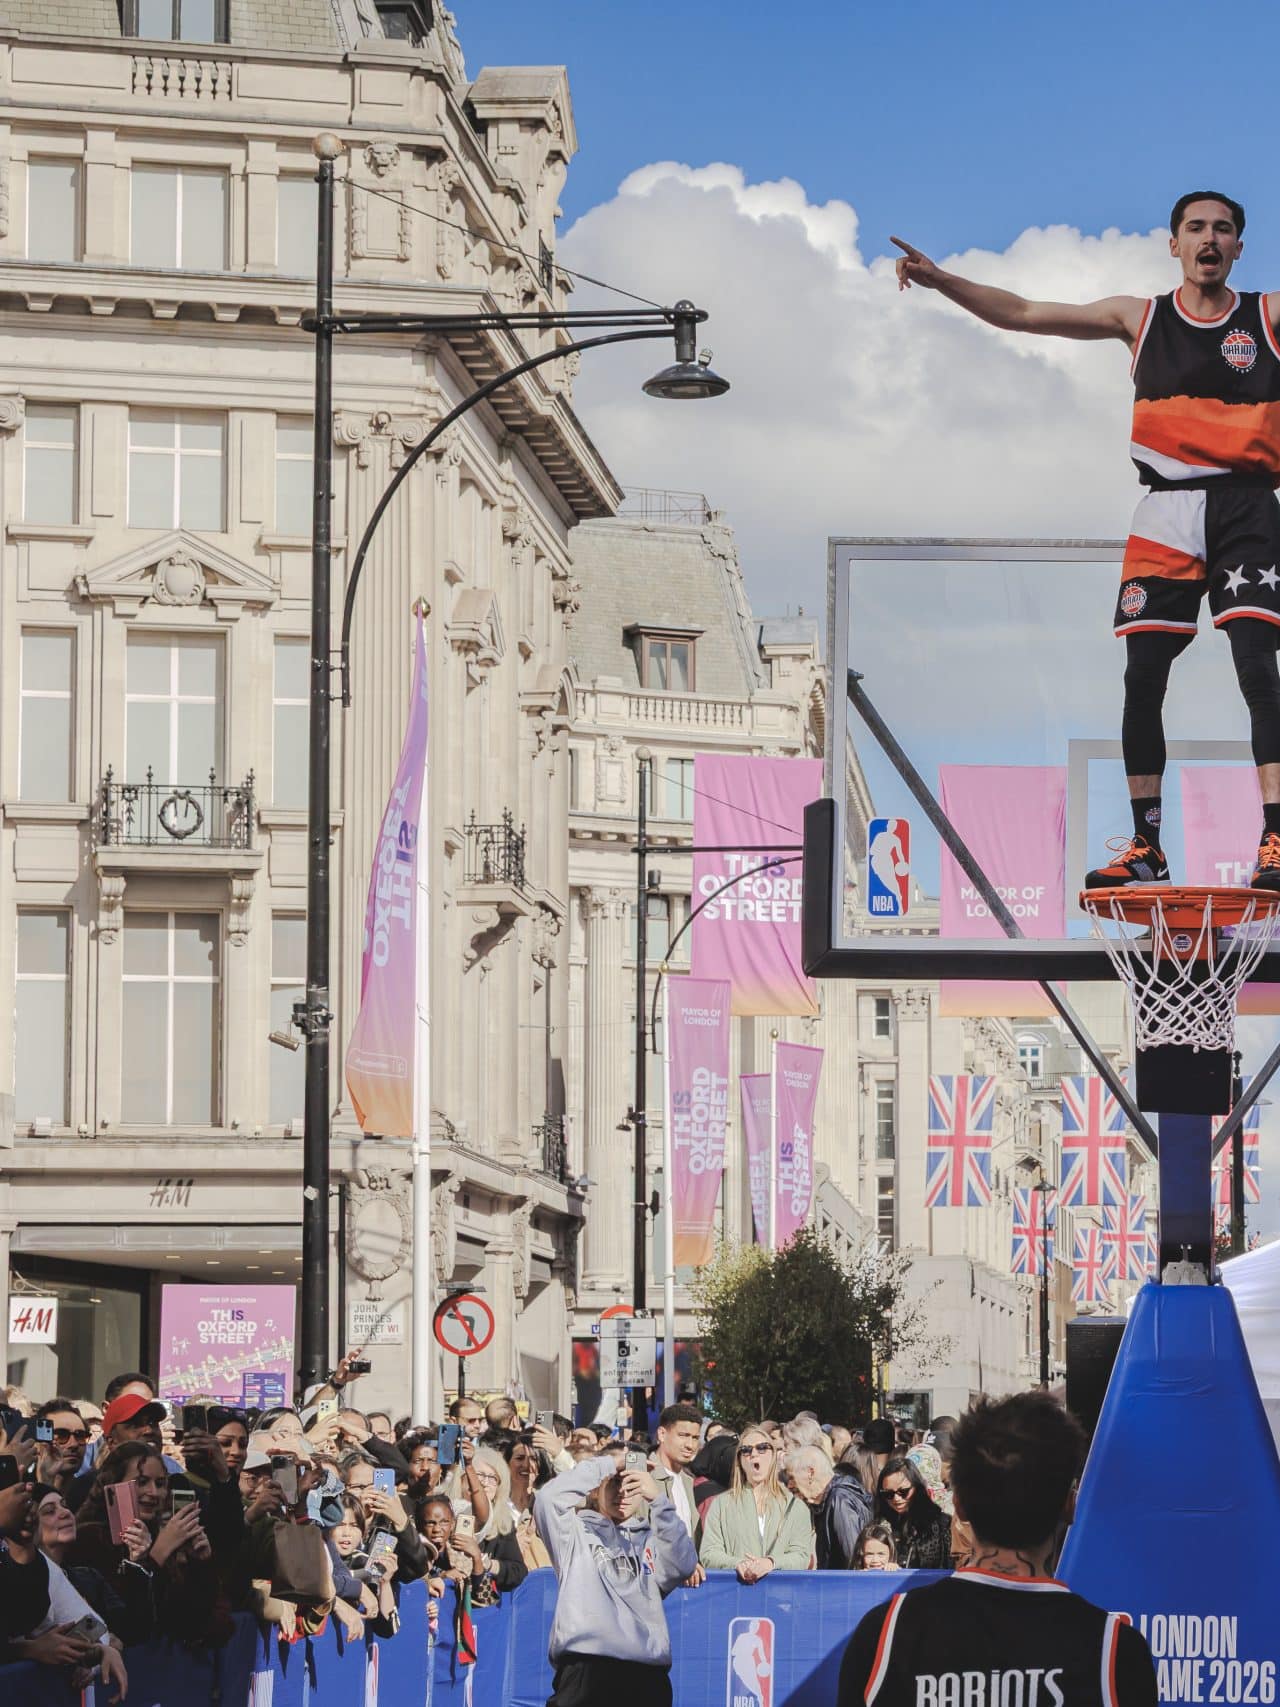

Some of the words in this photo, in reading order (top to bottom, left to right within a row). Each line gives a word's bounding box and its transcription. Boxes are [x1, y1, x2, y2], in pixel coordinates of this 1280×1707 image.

[724, 854, 785, 877] THIS
[872, 896, 894, 911] NBA
[960, 887, 1018, 900] MOR
[1022, 887, 1045, 900] OF
[703, 898, 802, 922] STREET
[966, 904, 1039, 917] LOON
[673, 1090, 691, 1149] THIS
[689, 1067, 711, 1175] OXFORD
[705, 1072, 728, 1171] STREET
[778, 1141, 793, 1194] THIS
[150, 1179, 193, 1207] H&M
[13, 1307, 53, 1333] H&M
[210, 1309, 245, 1321] THIS
[353, 1304, 378, 1313] JOHN
[197, 1321, 257, 1332] OXFORD
[200, 1332, 255, 1344] STREET
[353, 1325, 384, 1333] STREET
[1157, 1659, 1205, 1702] AME
[1209, 1659, 1276, 1704] 2026
